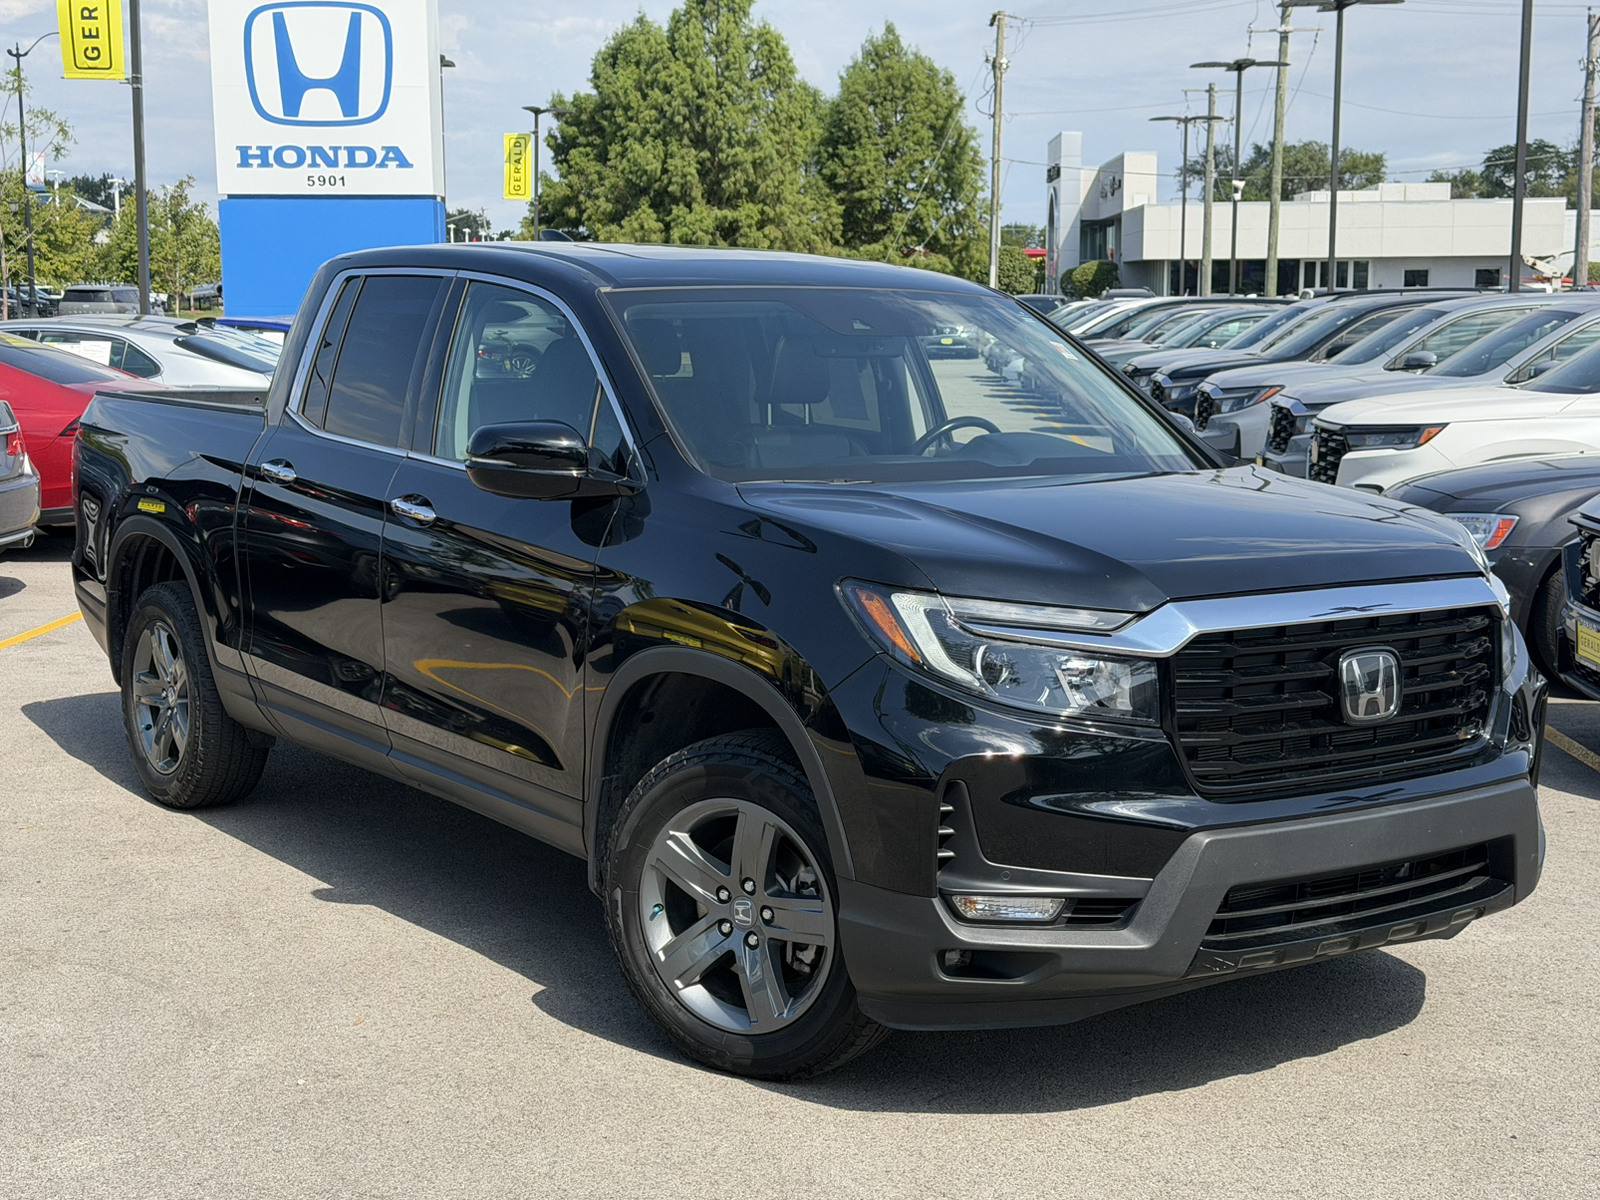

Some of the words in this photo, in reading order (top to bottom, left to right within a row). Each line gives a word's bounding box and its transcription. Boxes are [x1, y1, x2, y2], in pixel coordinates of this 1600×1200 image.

[235, 145, 414, 169] HONDA
[513, 140, 522, 192] GERALD
[306, 175, 346, 187] 5901
